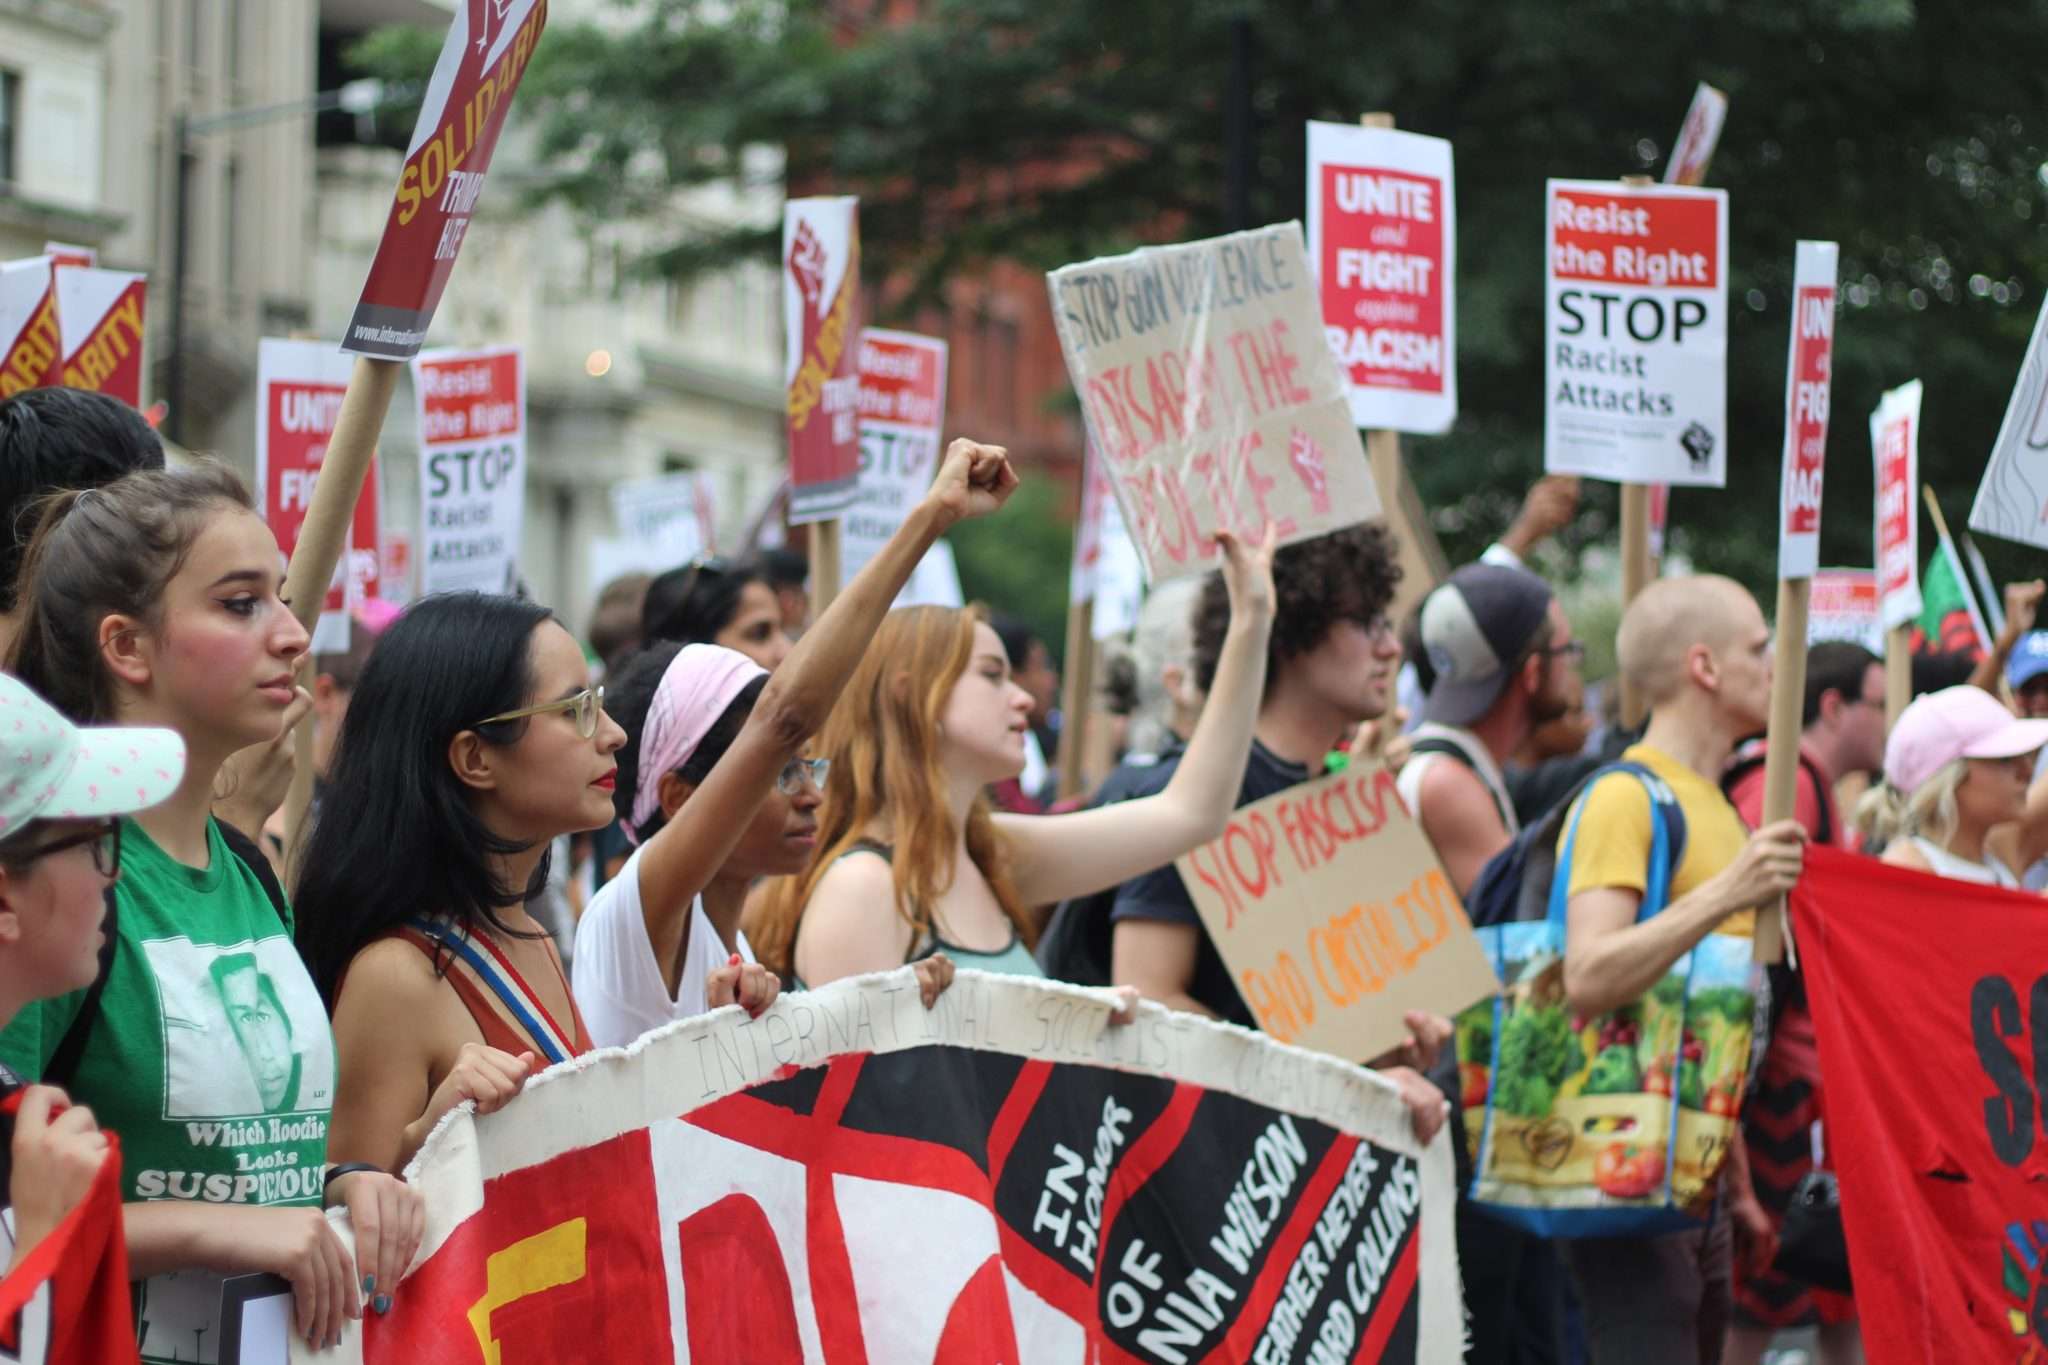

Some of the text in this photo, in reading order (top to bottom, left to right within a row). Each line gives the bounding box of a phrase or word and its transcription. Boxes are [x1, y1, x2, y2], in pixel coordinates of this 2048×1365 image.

[1335, 172, 1433, 222] UNITE
[1555, 197, 1650, 236] Resist
[1336, 248, 1433, 296] FIGHT
[1553, 242, 1708, 284] the Right
[1557, 291, 1708, 344] STOP
[1556, 342, 1647, 378] Racist
[1556, 378, 1674, 417] Attacks
[429, 445, 514, 498] STOP
[187, 1116, 326, 1148] Which Hoodie
[235, 1150, 298, 1171] Looks
[1033, 1143, 1085, 1248] IN
[1107, 1238, 1163, 1328] OF
[1252, 1241, 1331, 1365] EATHER
[1136, 1268, 1237, 1365] NIA
